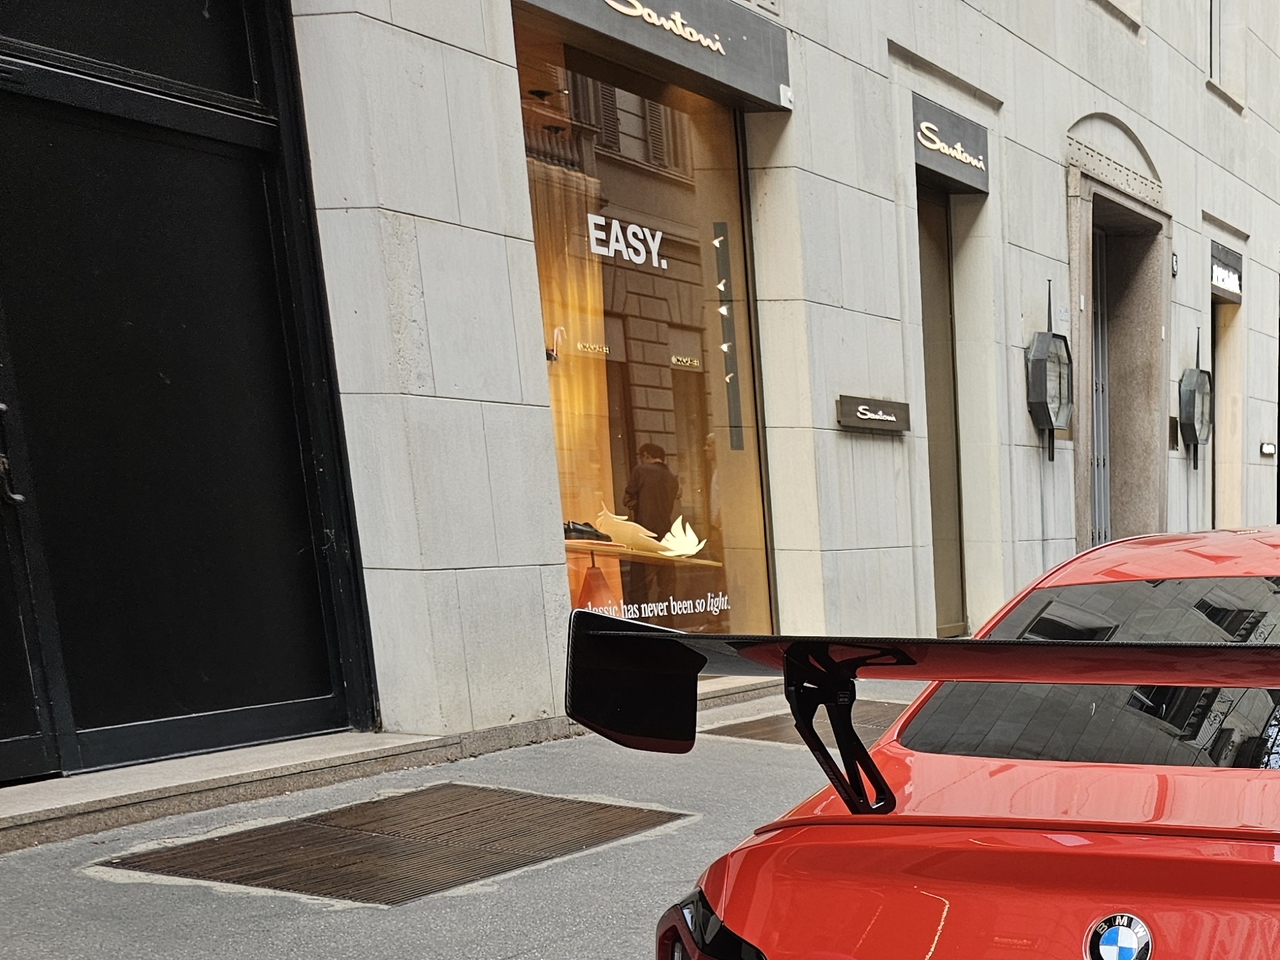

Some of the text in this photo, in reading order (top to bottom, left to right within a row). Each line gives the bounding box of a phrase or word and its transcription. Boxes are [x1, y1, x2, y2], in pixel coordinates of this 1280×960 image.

[917, 122, 985, 171] Santoni
[587, 213, 668, 269] EASY.
[857, 405, 897, 421] Santoni
[620, 599, 640, 619] has
[641, 601, 669, 618] never
[669, 595, 695, 615] been
[695, 599, 706, 613] so
[1096, 915, 1147, 938] BMW
